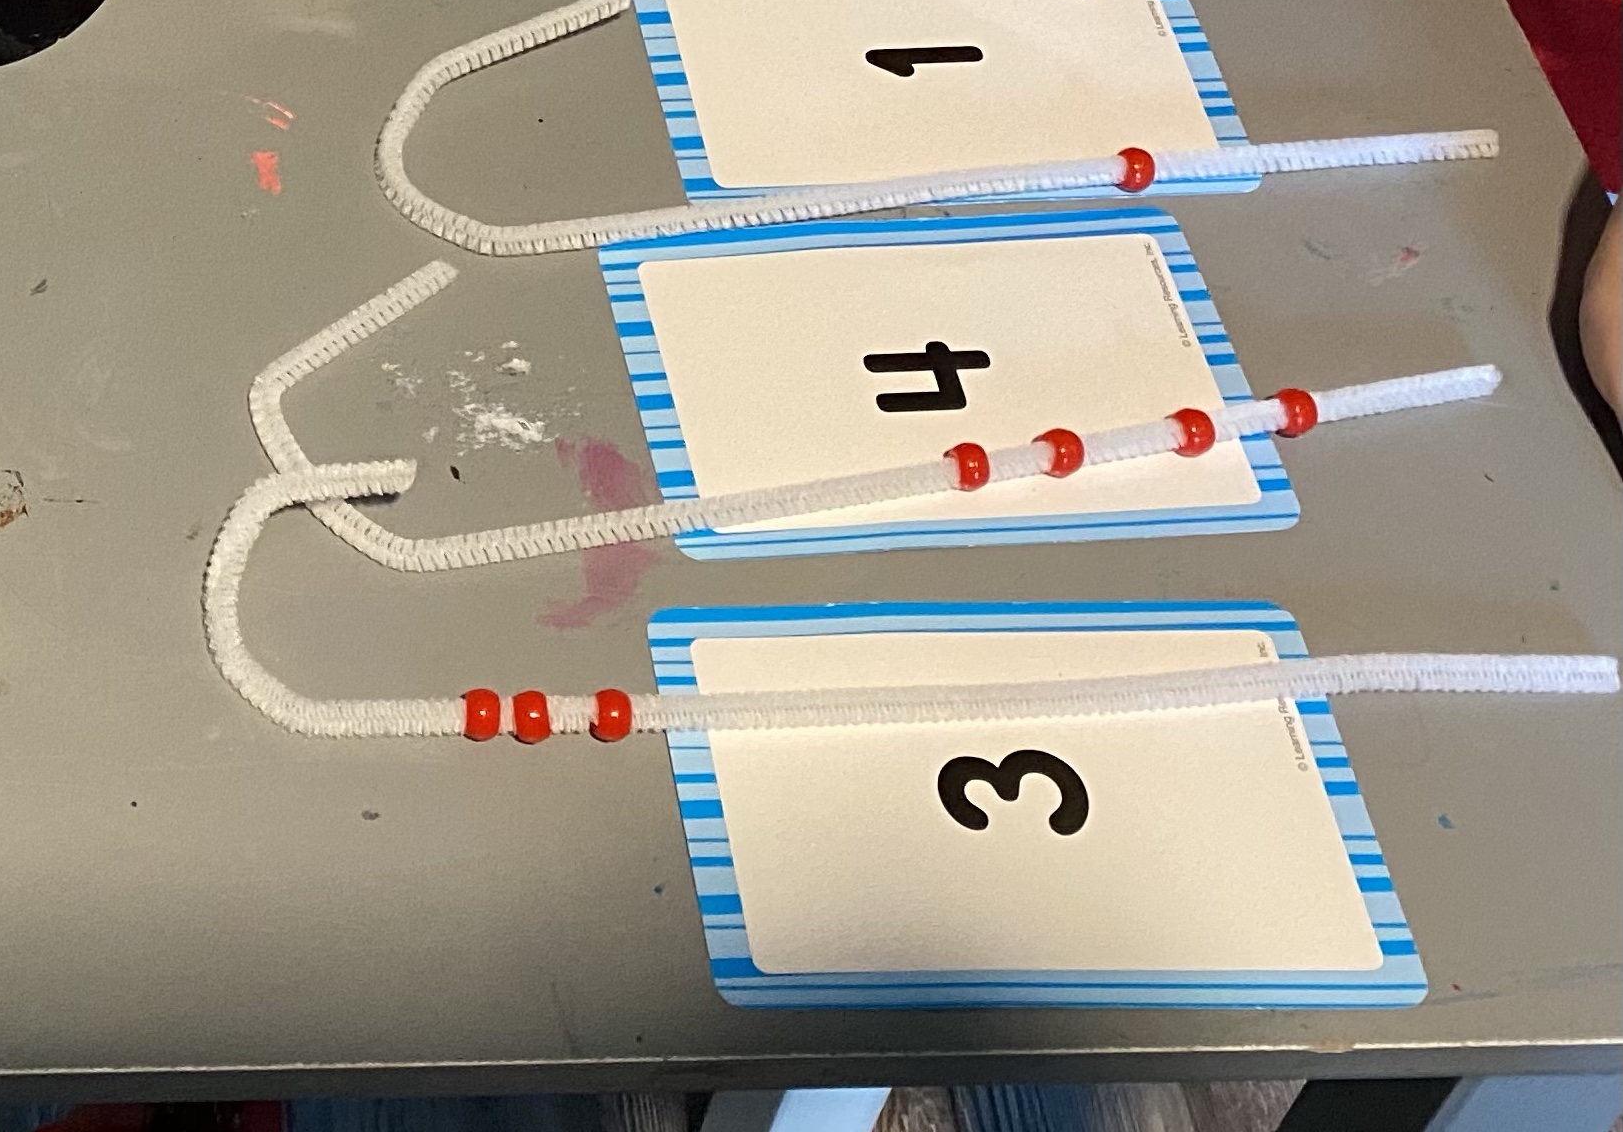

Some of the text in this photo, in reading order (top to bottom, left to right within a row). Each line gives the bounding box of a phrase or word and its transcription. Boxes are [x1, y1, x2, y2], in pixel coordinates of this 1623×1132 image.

[866, 46, 983, 77] 1
[863, 341, 991, 413] 4
[1283, 716, 1304, 760] Learning
[937, 749, 1089, 836] 3
